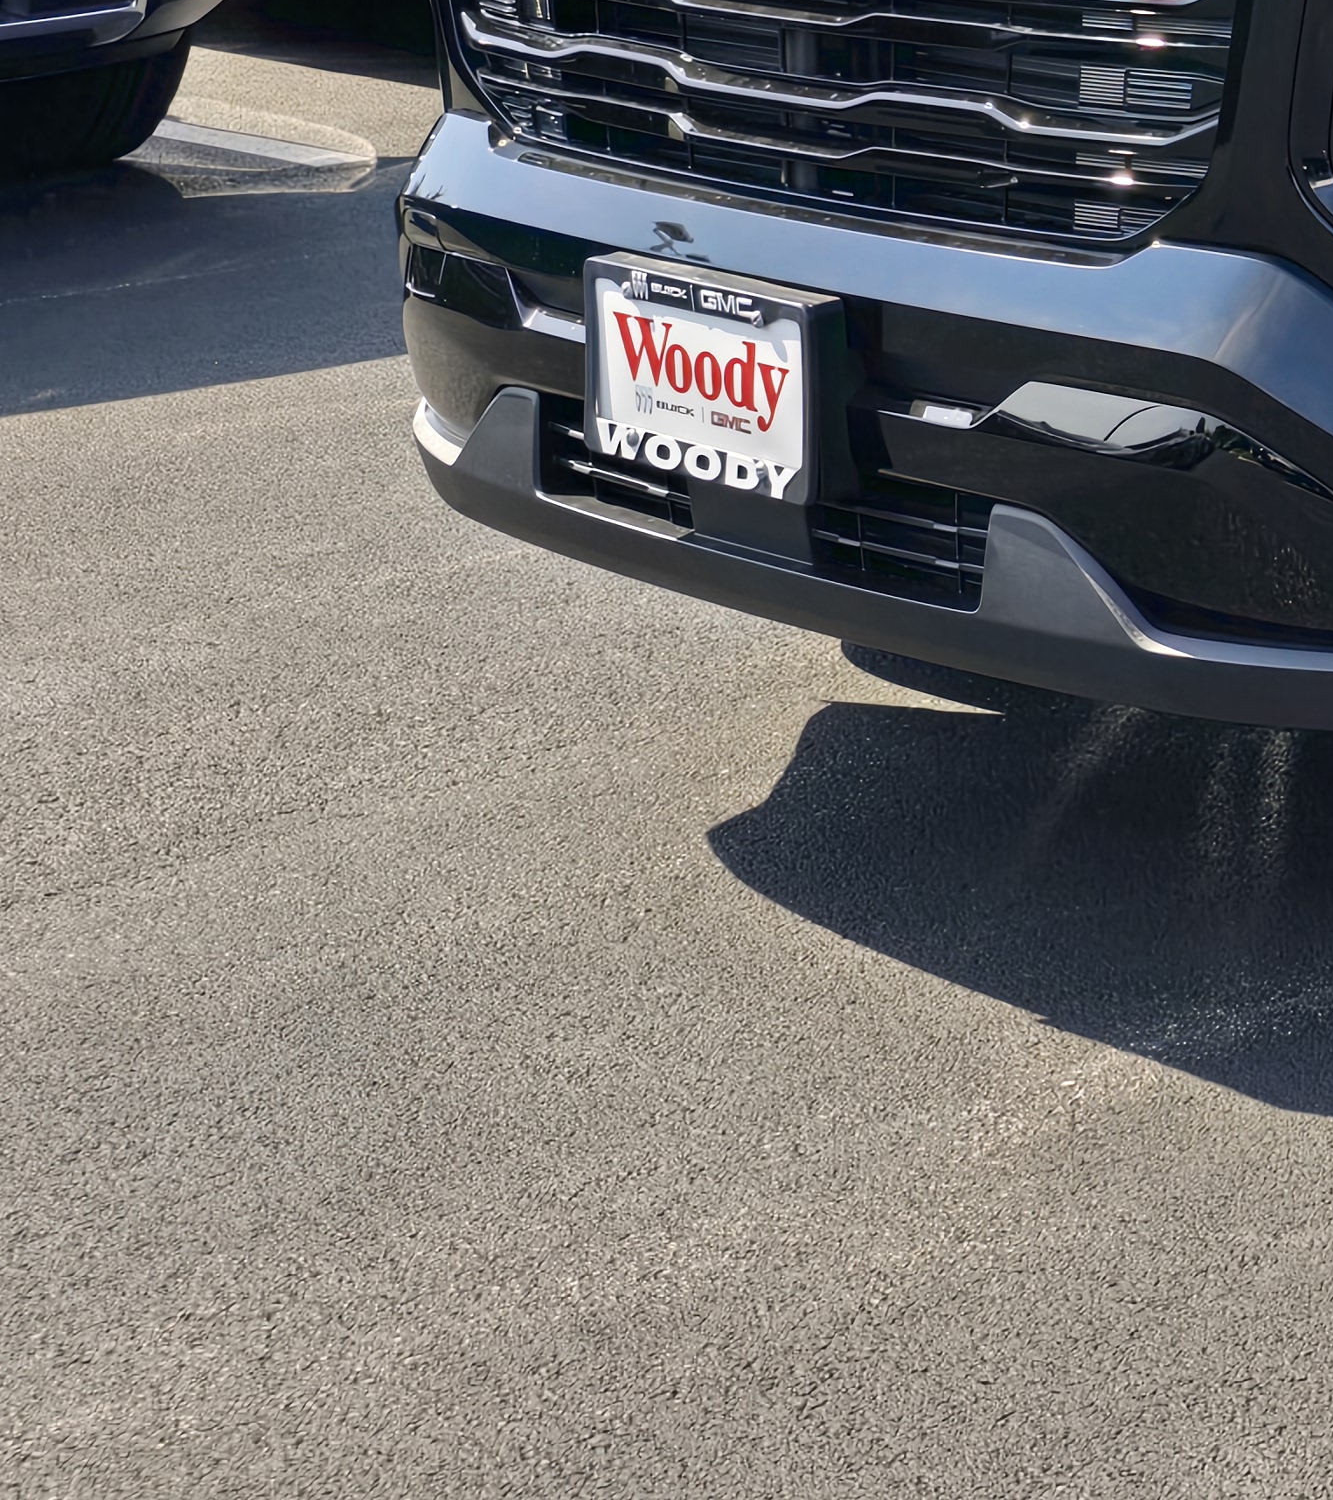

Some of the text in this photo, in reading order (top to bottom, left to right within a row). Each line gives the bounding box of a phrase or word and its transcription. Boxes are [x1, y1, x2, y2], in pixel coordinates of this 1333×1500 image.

[700, 290, 753, 316] GMC
[613, 311, 790, 432] Woody
[710, 410, 752, 435] GMC
[596, 417, 801, 500] WOODY
